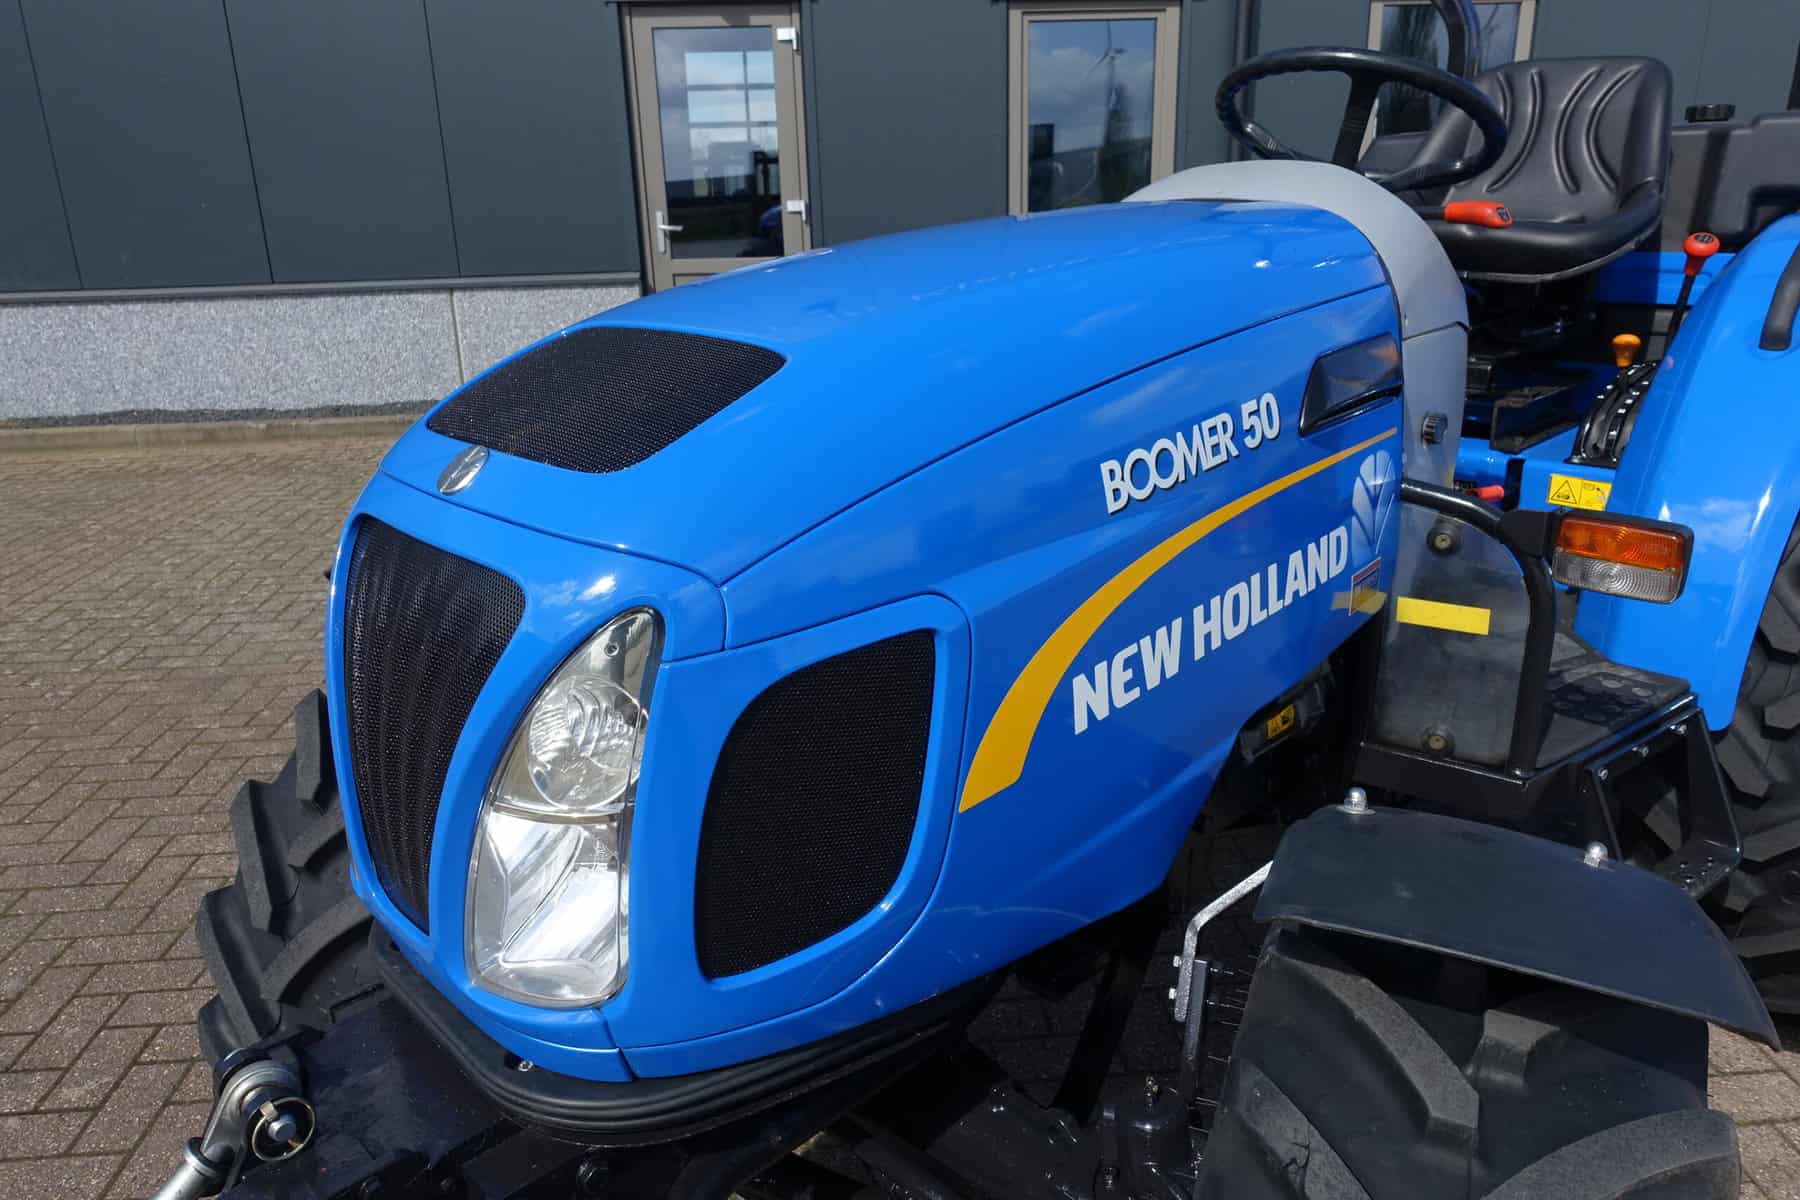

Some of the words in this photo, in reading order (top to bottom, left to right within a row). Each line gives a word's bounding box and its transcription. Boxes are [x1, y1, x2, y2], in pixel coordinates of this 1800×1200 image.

[1100, 413, 1239, 513] BOOMER
[1241, 392, 1280, 449] 50
[1072, 617, 1183, 735] NEW
[1193, 526, 1349, 661] HOLLAND
